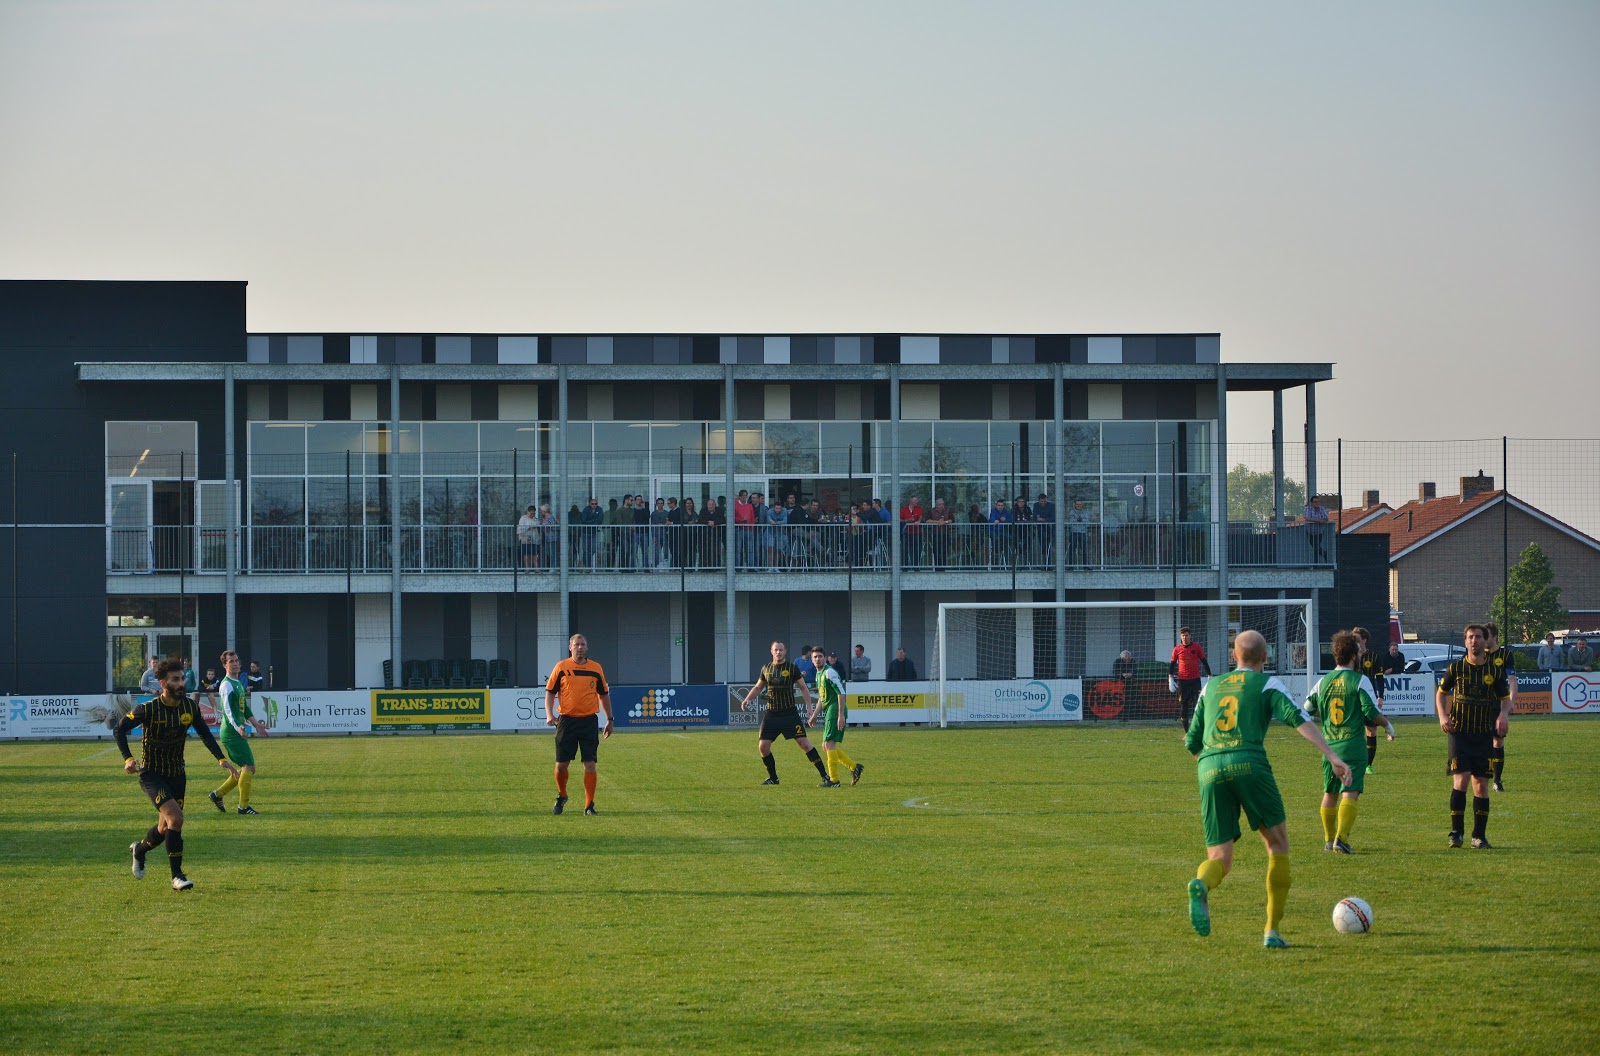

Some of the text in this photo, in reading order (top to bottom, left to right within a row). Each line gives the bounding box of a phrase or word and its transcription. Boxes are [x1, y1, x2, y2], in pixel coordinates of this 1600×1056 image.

[284, 694, 312, 702] Tuinen
[857, 695, 917, 704] EMPTEEZY
[1382, 693, 1426, 701] gheidskledij
[42, 698, 80, 707] GROOTE
[380, 697, 481, 711] TRANS-BETON
[30, 707, 80, 717] RAMMANT
[284, 704, 367, 720] Johan Terras
[656, 706, 710, 717] adirack.be
[1215, 695, 1239, 732] 3
[1329, 697, 1344, 725] 6
[795, 724, 802, 734] 2
